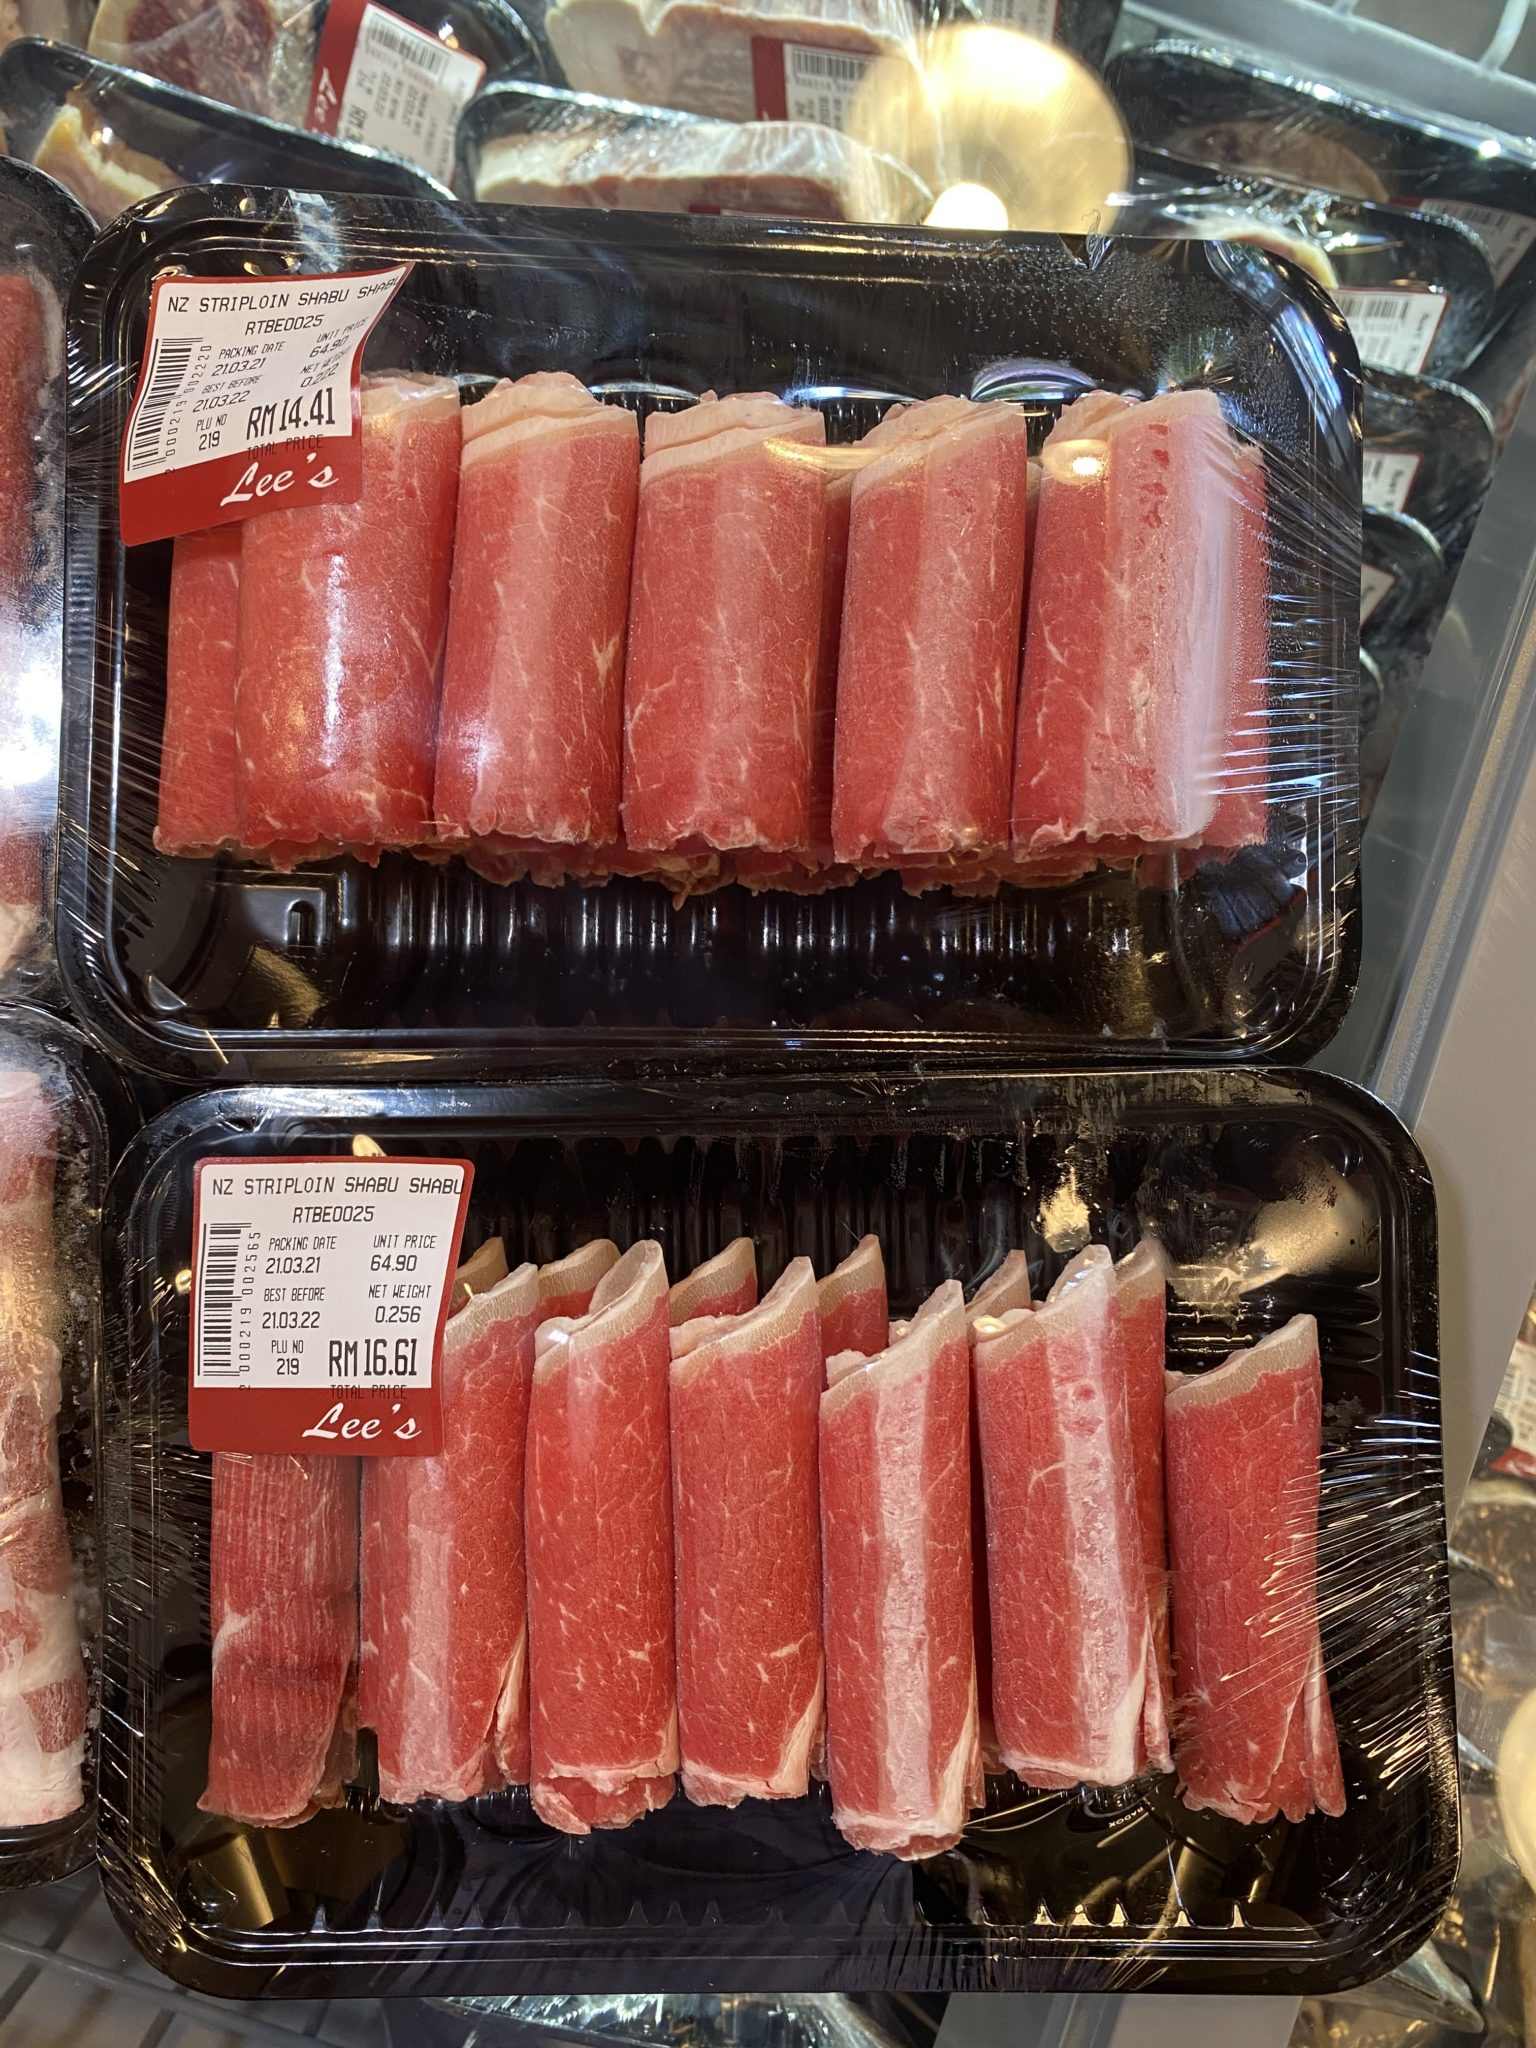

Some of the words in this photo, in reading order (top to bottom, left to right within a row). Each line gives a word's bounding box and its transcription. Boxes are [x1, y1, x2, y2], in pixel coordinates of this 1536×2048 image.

[168, 296, 188, 313] NZ
[199, 293, 290, 313] STRIPLOIN
[298, 289, 350, 307] SHABU
[244, 314, 325, 336] RTBE0025
[316, 328, 341, 344] UNIT
[342, 316, 370, 335] PRICE
[218, 344, 259, 360] PACKING
[260, 341, 286, 354] DATE
[309, 335, 349, 358] 64.90
[211, 358, 267, 377] 21.03.21
[300, 362, 320, 375] NET
[300, 363, 340, 388] 0.222
[202, 381, 226, 395] BEST
[228, 374, 263, 391] BEFORE
[192, 390, 251, 413] 21.03.22
[195, 416, 214, 432] PLU
[216, 414, 228, 427] NO
[198, 431, 221, 451] 219
[247, 441, 277, 460] TOTAL
[285, 434, 324, 452] PRICE
[220, 452, 339, 507] Lee's
[212, 1178, 233, 1195] NZ
[244, 1176, 335, 1195] STRIPLOIN
[344, 1176, 400, 1194] SHABU
[408, 1177, 464, 1195] SHABU
[292, 1205, 375, 1224] RTBE0025
[269, 1236, 309, 1251] PACKING
[312, 1235, 338, 1250] DATE
[373, 1234, 401, 1249] UNIT
[403, 1235, 437, 1249] PRICE
[265, 1257, 321, 1274] 21.03.21
[370, 1254, 418, 1272] 64.90
[263, 1287, 288, 1302] BEST
[291, 1286, 326, 1301] BEFORE
[368, 1284, 388, 1299] NET
[391, 1284, 432, 1299] WEIGHT
[262, 1311, 321, 1329] 21.03.22
[374, 1305, 421, 1323] 0.256
[271, 1340, 288, 1354] PLU
[292, 1339, 304, 1354] NO
[276, 1357, 300, 1375] 219
[330, 1384, 364, 1399] TOTAL
[371, 1384, 408, 1399] PRICE
[301, 1402, 422, 1440] Lee's
